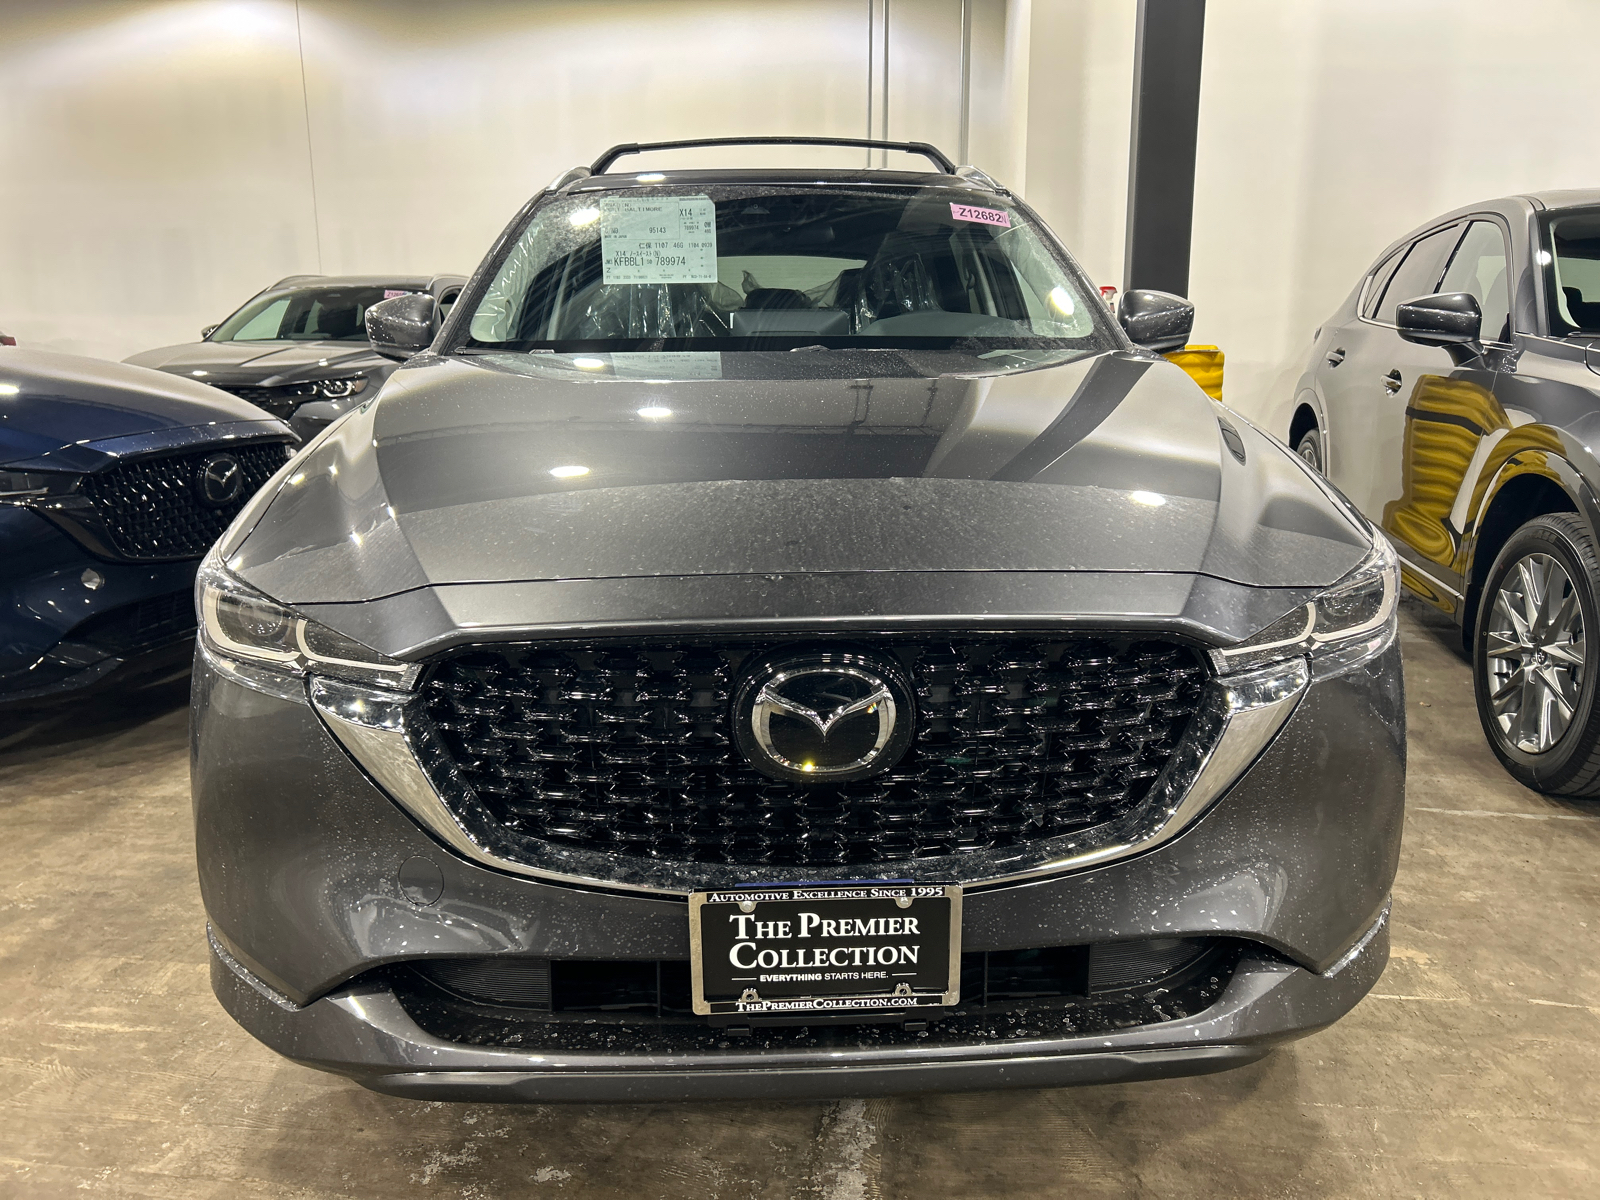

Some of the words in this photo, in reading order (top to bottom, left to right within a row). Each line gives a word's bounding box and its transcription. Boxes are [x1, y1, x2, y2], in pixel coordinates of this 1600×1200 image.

[679, 208, 693, 217] X14
[958, 207, 1002, 223] Z12682
[648, 226, 667, 234] 95143
[655, 241, 668, 249] 1107
[613, 256, 644, 266] KFBBL1
[655, 256, 686, 266] 789974
[709, 892, 790, 902] AUTOMOTIVE
[793, 890, 868, 900] EXCELLENCE
[870, 888, 906, 898] SINCE
[910, 886, 943, 897] 1995
[729, 913, 792, 940] THE
[798, 912, 920, 939] PREMIER
[729, 941, 921, 969] COLLECTION
[760, 973, 822, 982] EVERYTHING
[824, 972, 859, 981] STARTS
[861, 971, 889, 980] HERE.
